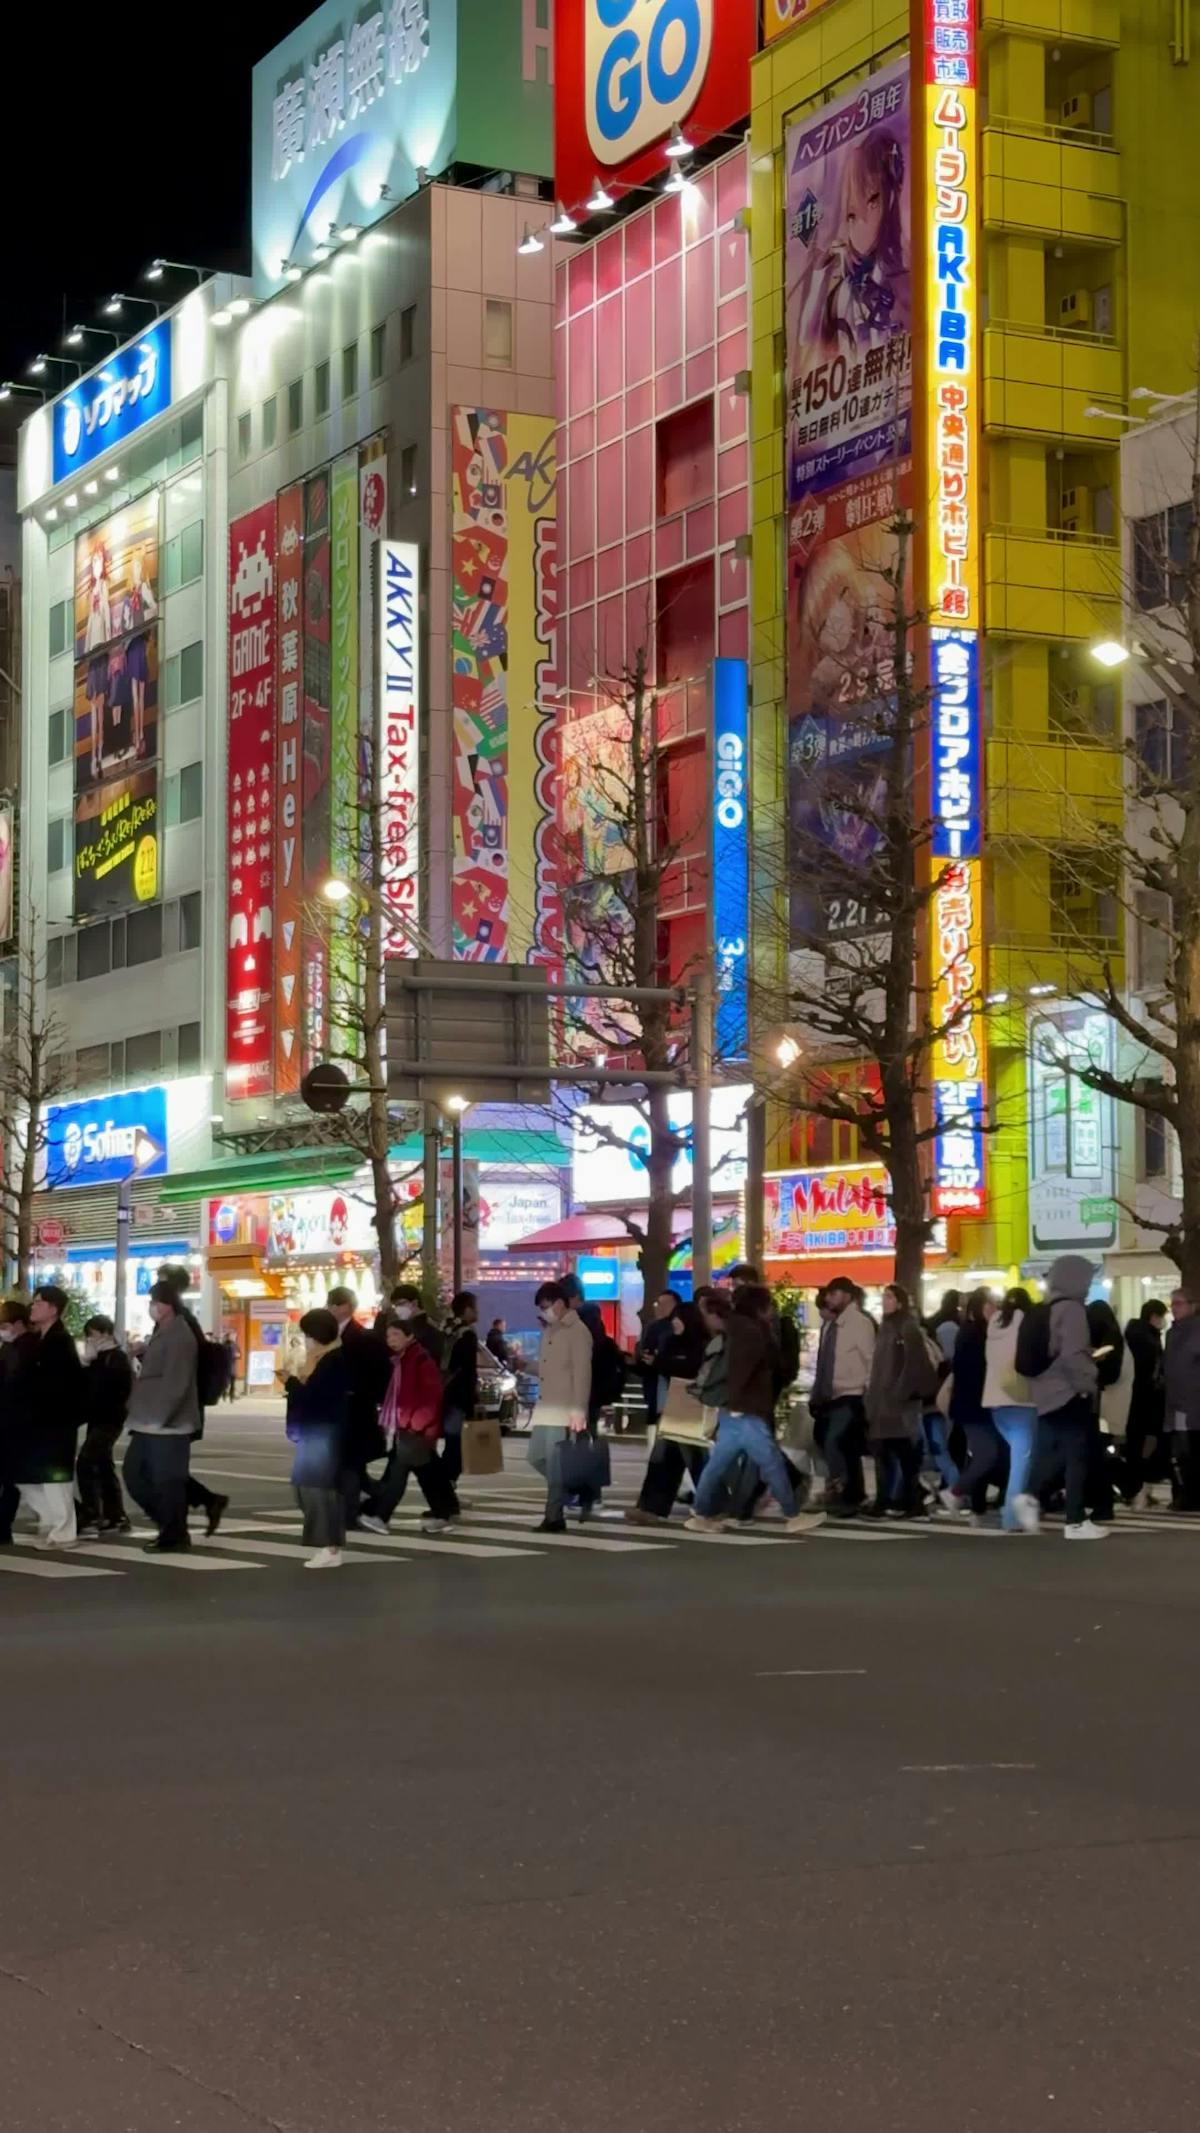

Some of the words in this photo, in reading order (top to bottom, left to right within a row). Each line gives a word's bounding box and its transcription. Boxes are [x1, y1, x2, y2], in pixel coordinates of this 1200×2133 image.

[934, 27, 969, 53] 販売
[934, 57, 969, 84] 市場
[83, 343, 157, 435] ソフマップ
[232, 618, 272, 678] GAME
[386, 704, 415, 867] Tax-free
[717, 732, 744, 829] GiGO
[938, 1081, 978, 1104] 2F
[508, 1195, 548, 1209] Japan
